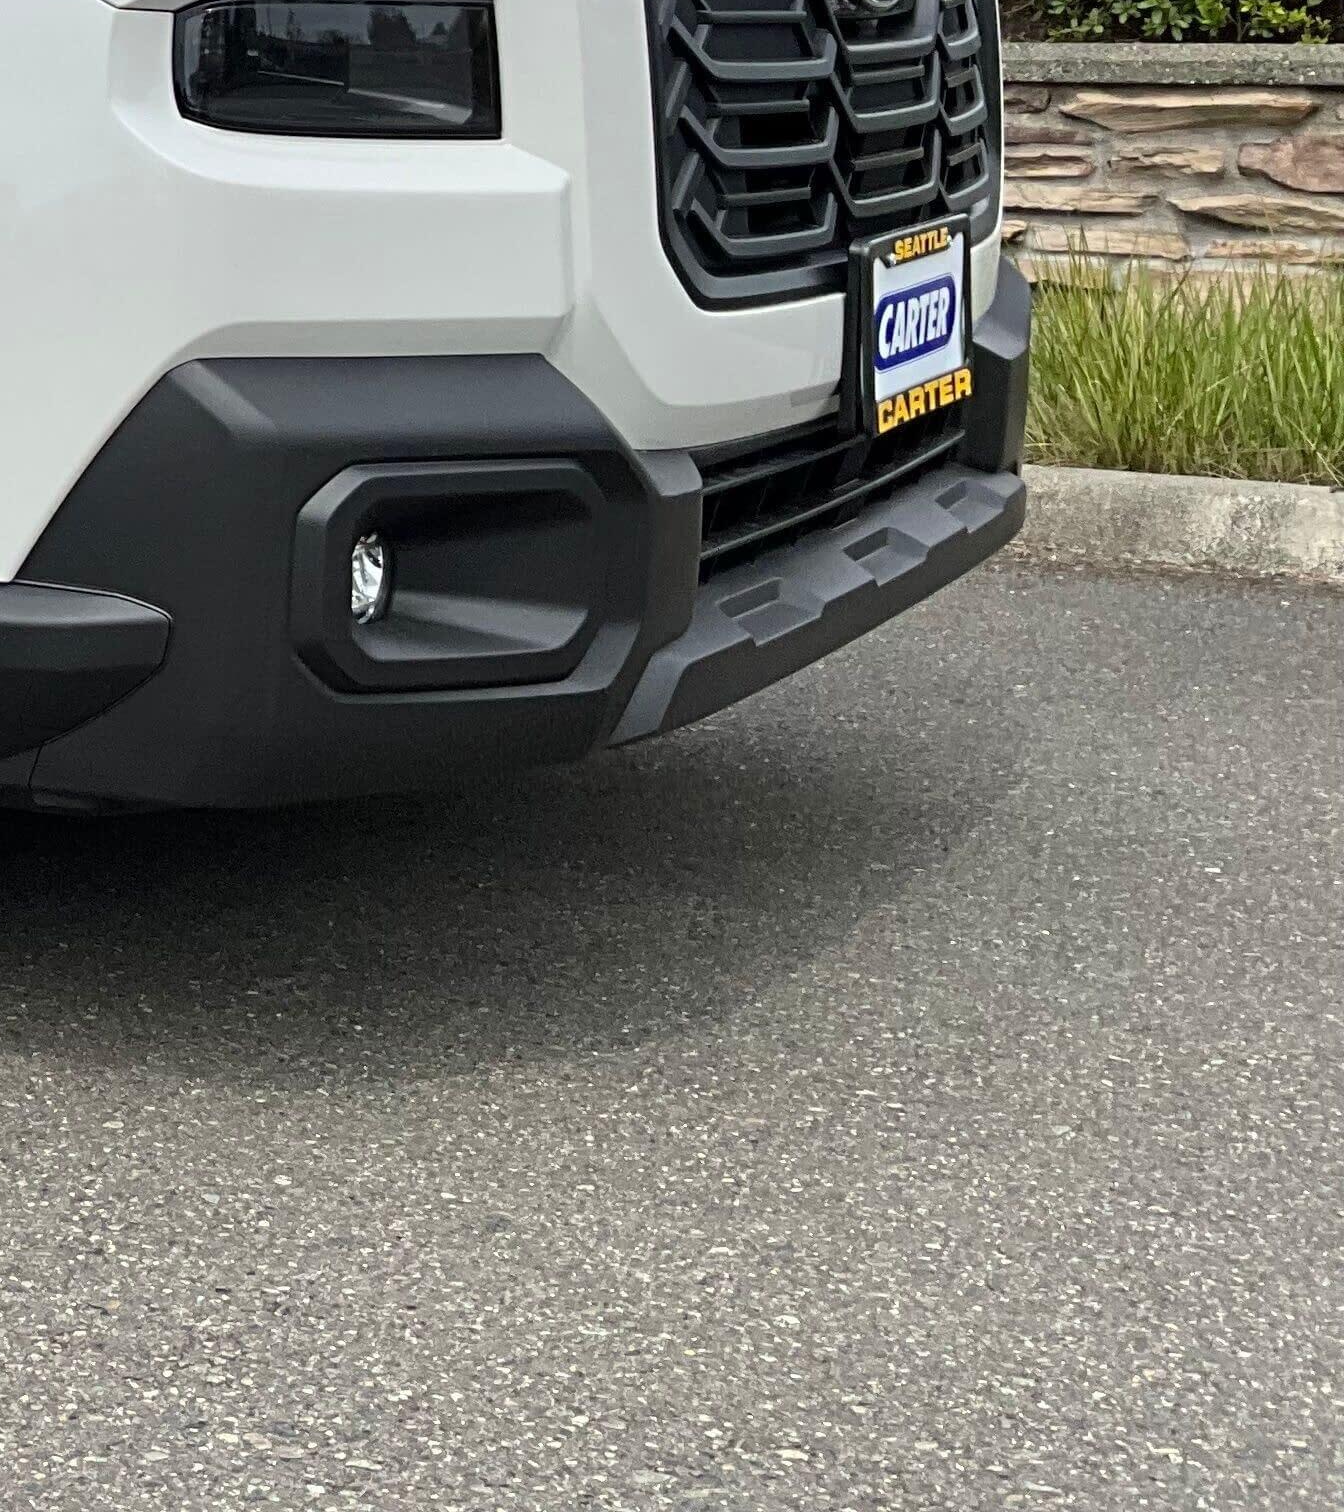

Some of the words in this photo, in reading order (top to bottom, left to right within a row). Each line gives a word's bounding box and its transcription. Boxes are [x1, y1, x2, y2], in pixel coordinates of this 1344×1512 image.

[894, 227, 949, 261] SEATTLE
[878, 286, 950, 359] CARTER
[878, 369, 973, 434] CARTER
